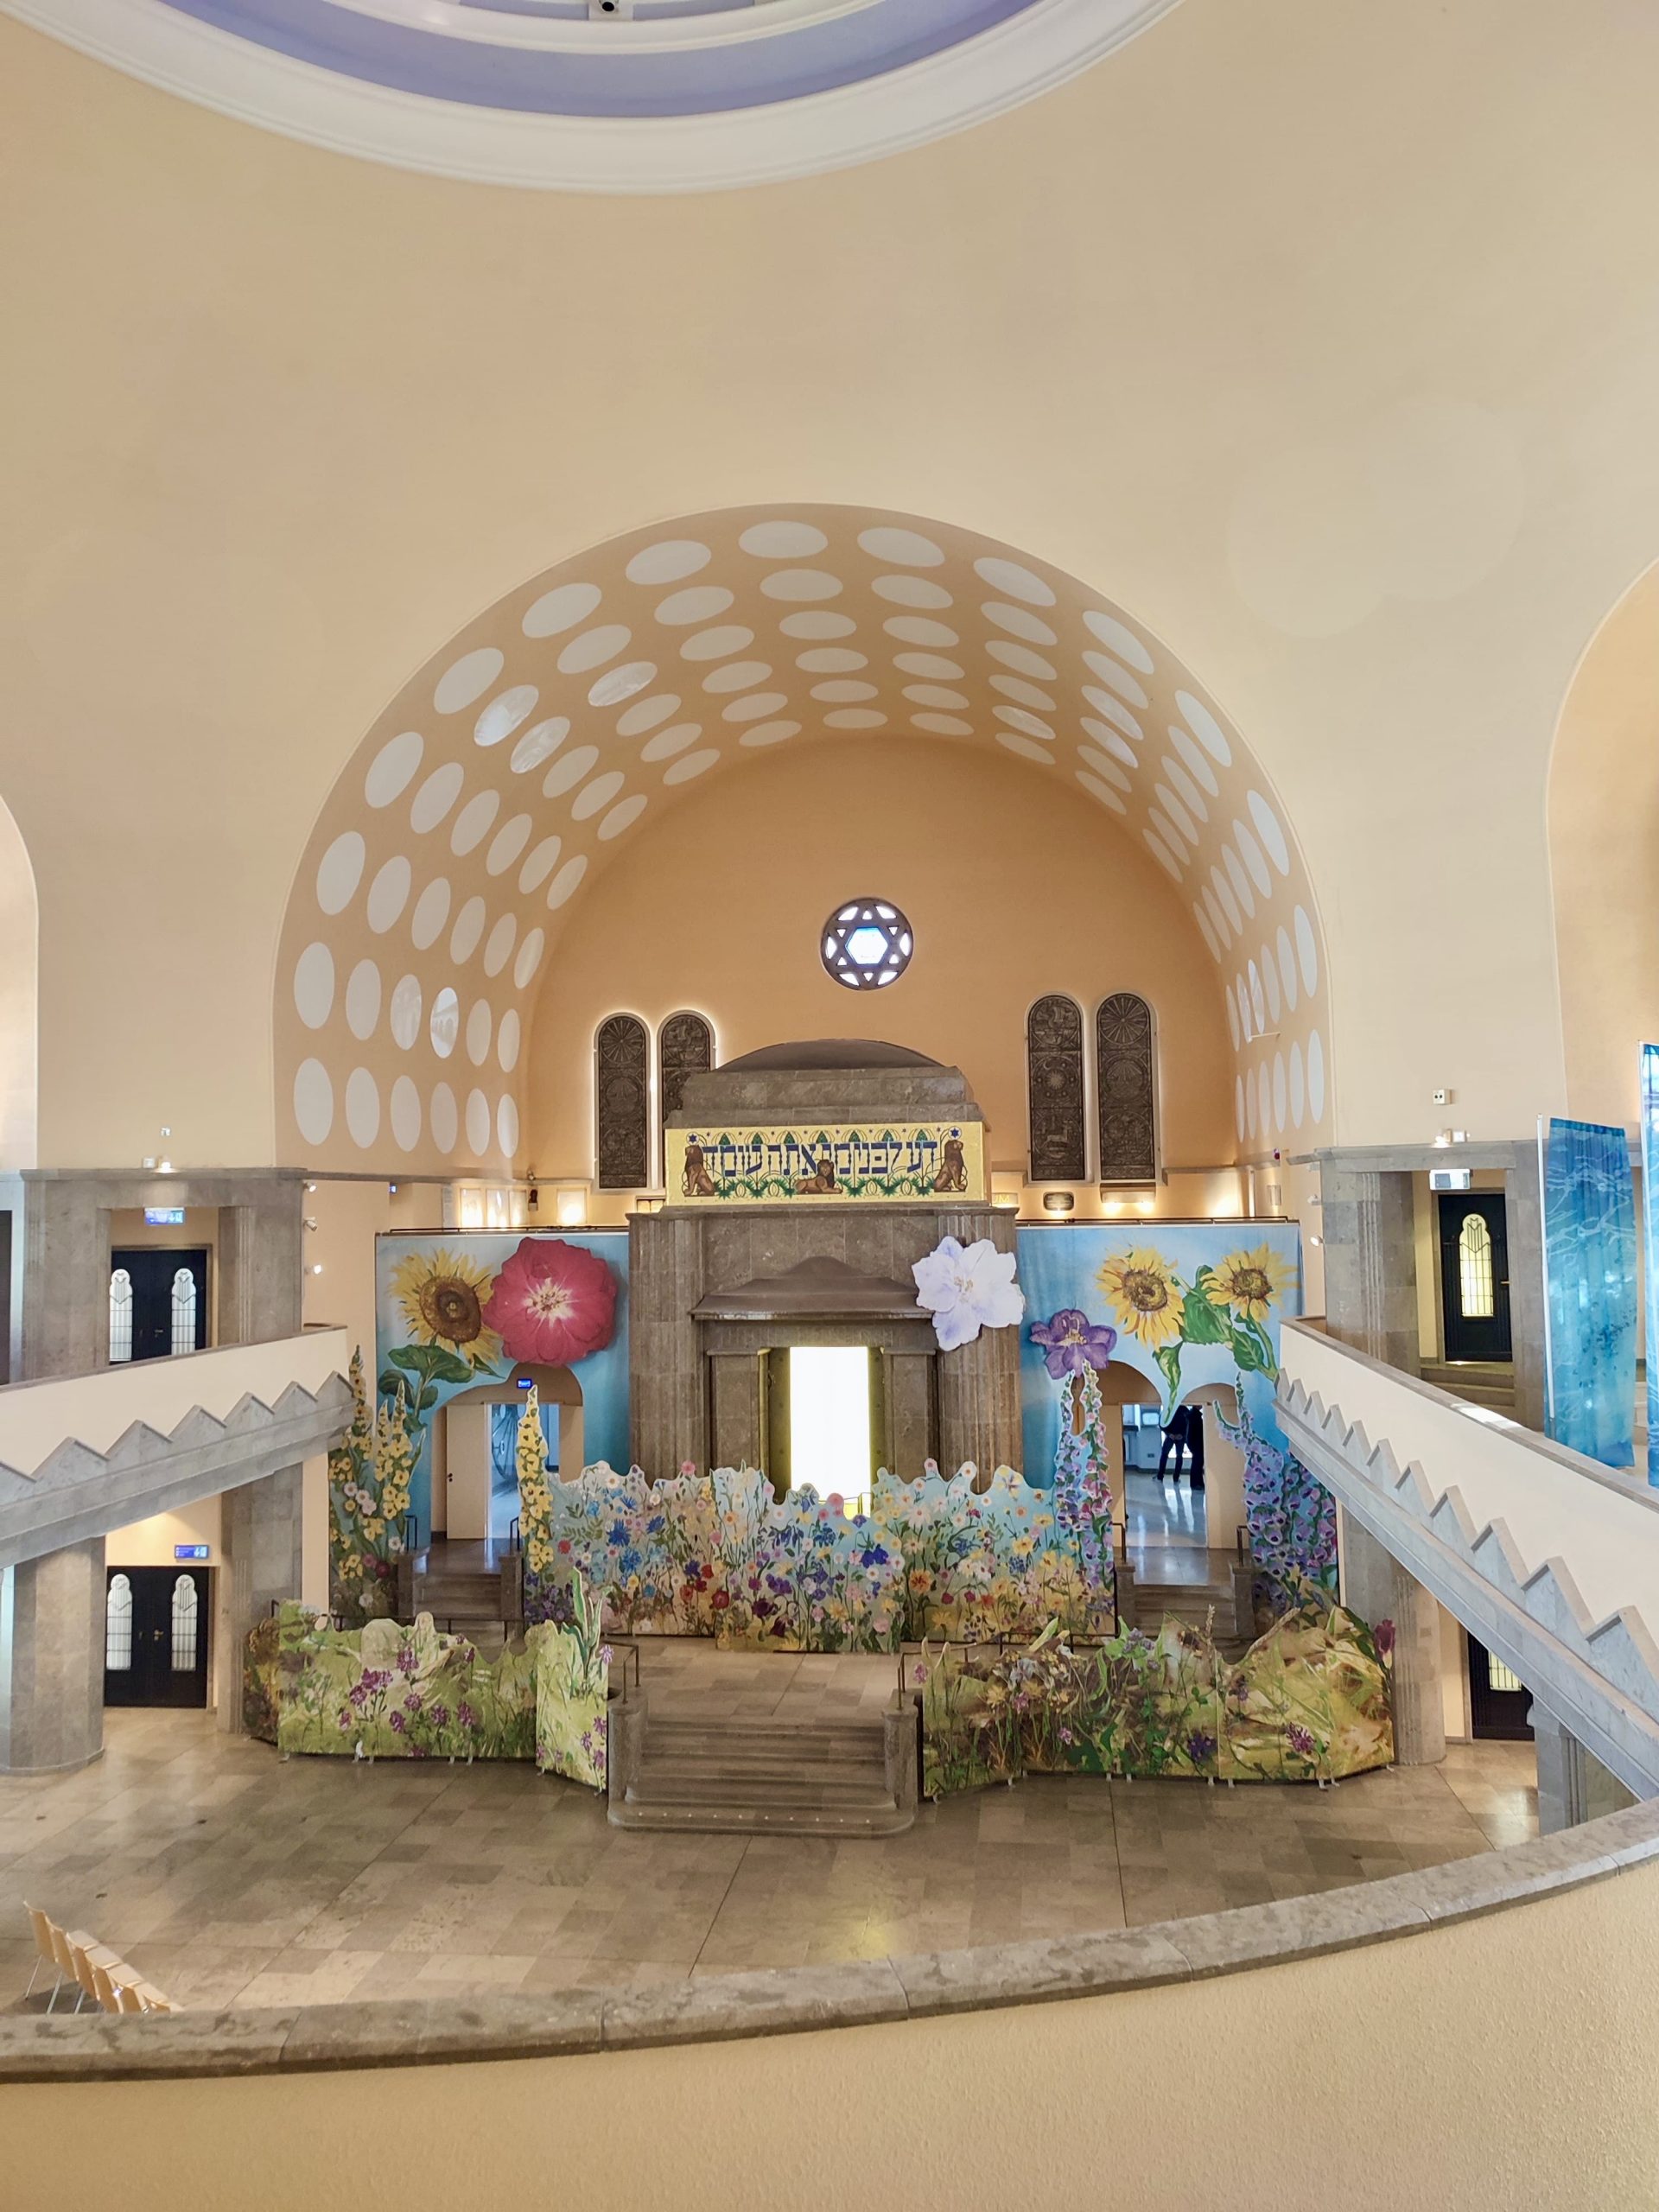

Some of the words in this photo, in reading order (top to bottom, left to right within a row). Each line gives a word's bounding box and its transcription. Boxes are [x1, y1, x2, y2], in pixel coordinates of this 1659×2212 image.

[702, 1145, 762, 1177] עומד
[766, 1143, 817, 1175] אתה
[822, 1143, 851, 1175] מי
[854, 1142, 902, 1174] לפני
[907, 1141, 938, 1173] דע
